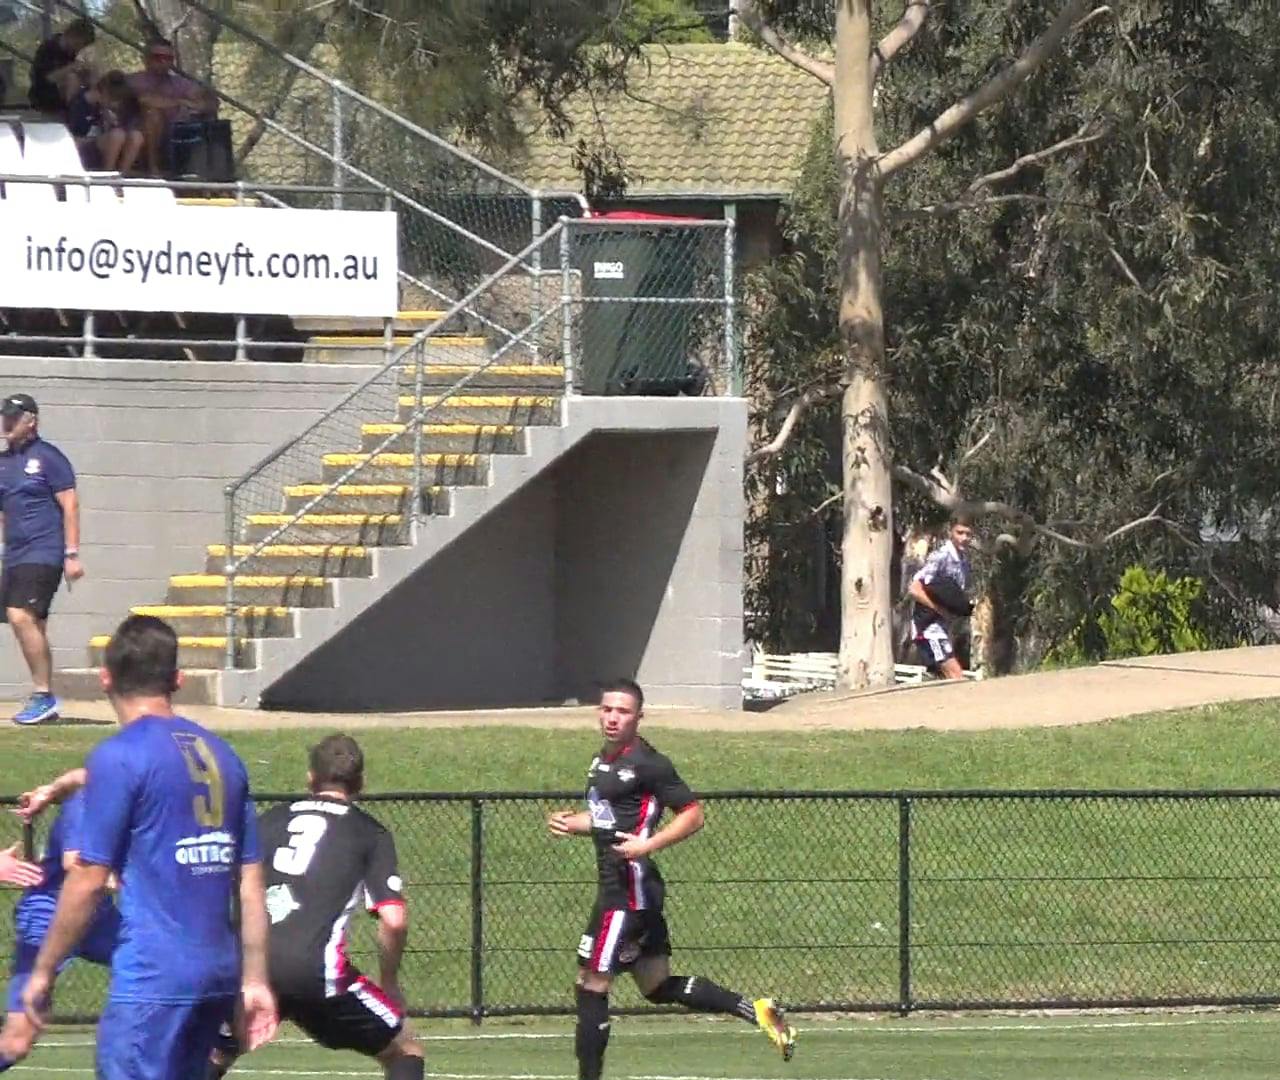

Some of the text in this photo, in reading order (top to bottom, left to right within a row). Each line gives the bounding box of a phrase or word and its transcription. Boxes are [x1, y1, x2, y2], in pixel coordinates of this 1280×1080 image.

[26, 235, 379, 285] info@sydneyft.com.au
[172, 732, 224, 828] 9
[273, 813, 328, 875] 3
